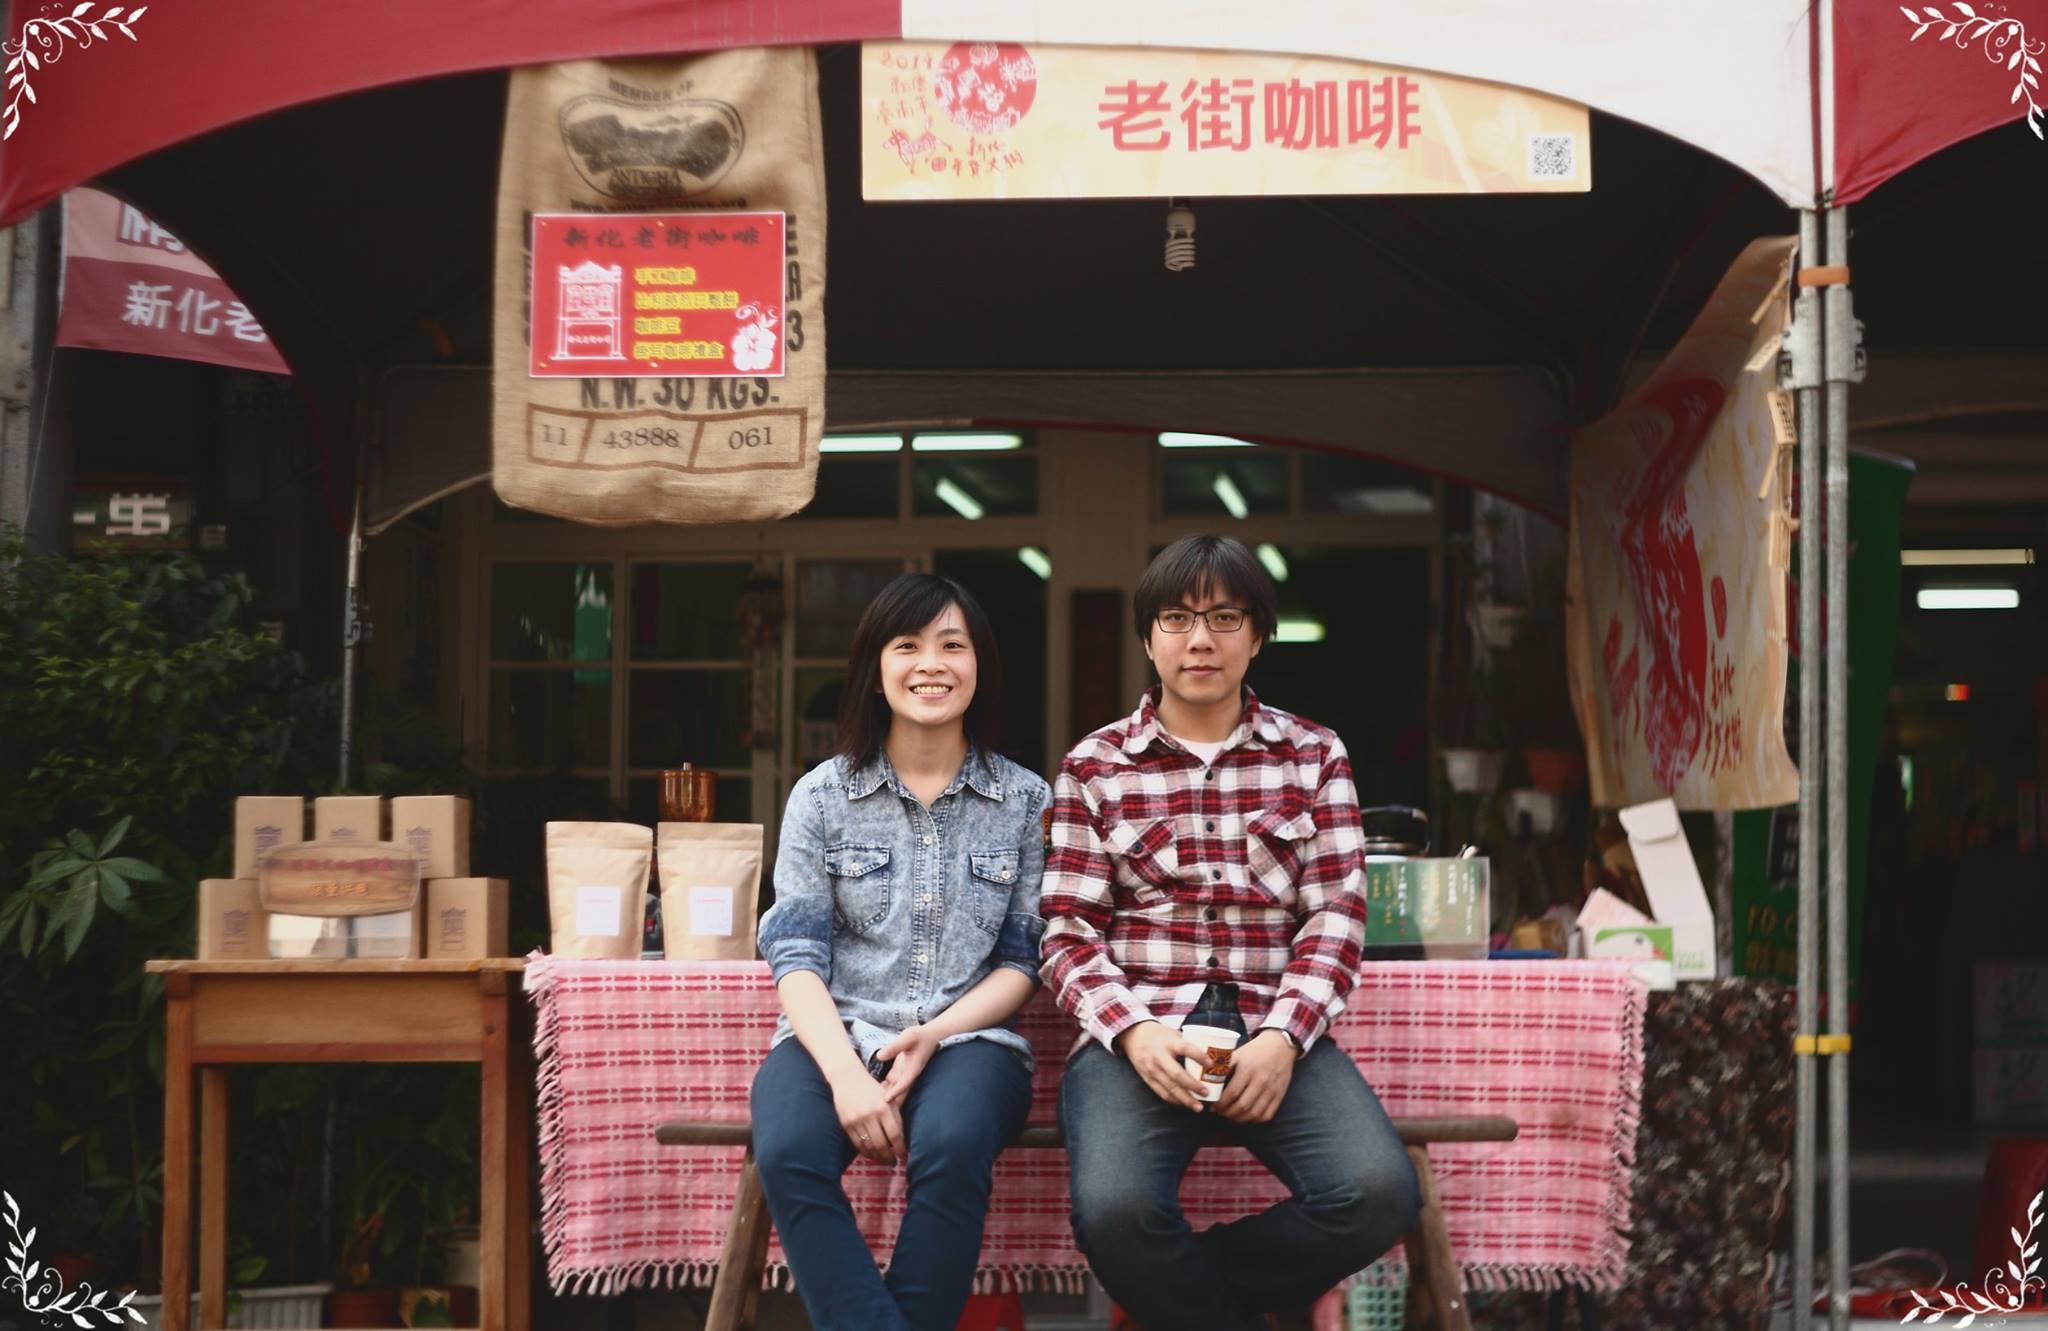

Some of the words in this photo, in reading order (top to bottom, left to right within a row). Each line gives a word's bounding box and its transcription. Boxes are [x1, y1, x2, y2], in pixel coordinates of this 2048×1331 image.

[1098, 77, 1421, 152] 老街咖啡
[706, 377, 780, 411] KGS.
[602, 427, 682, 450] 43888
[728, 426, 774, 450] 061
